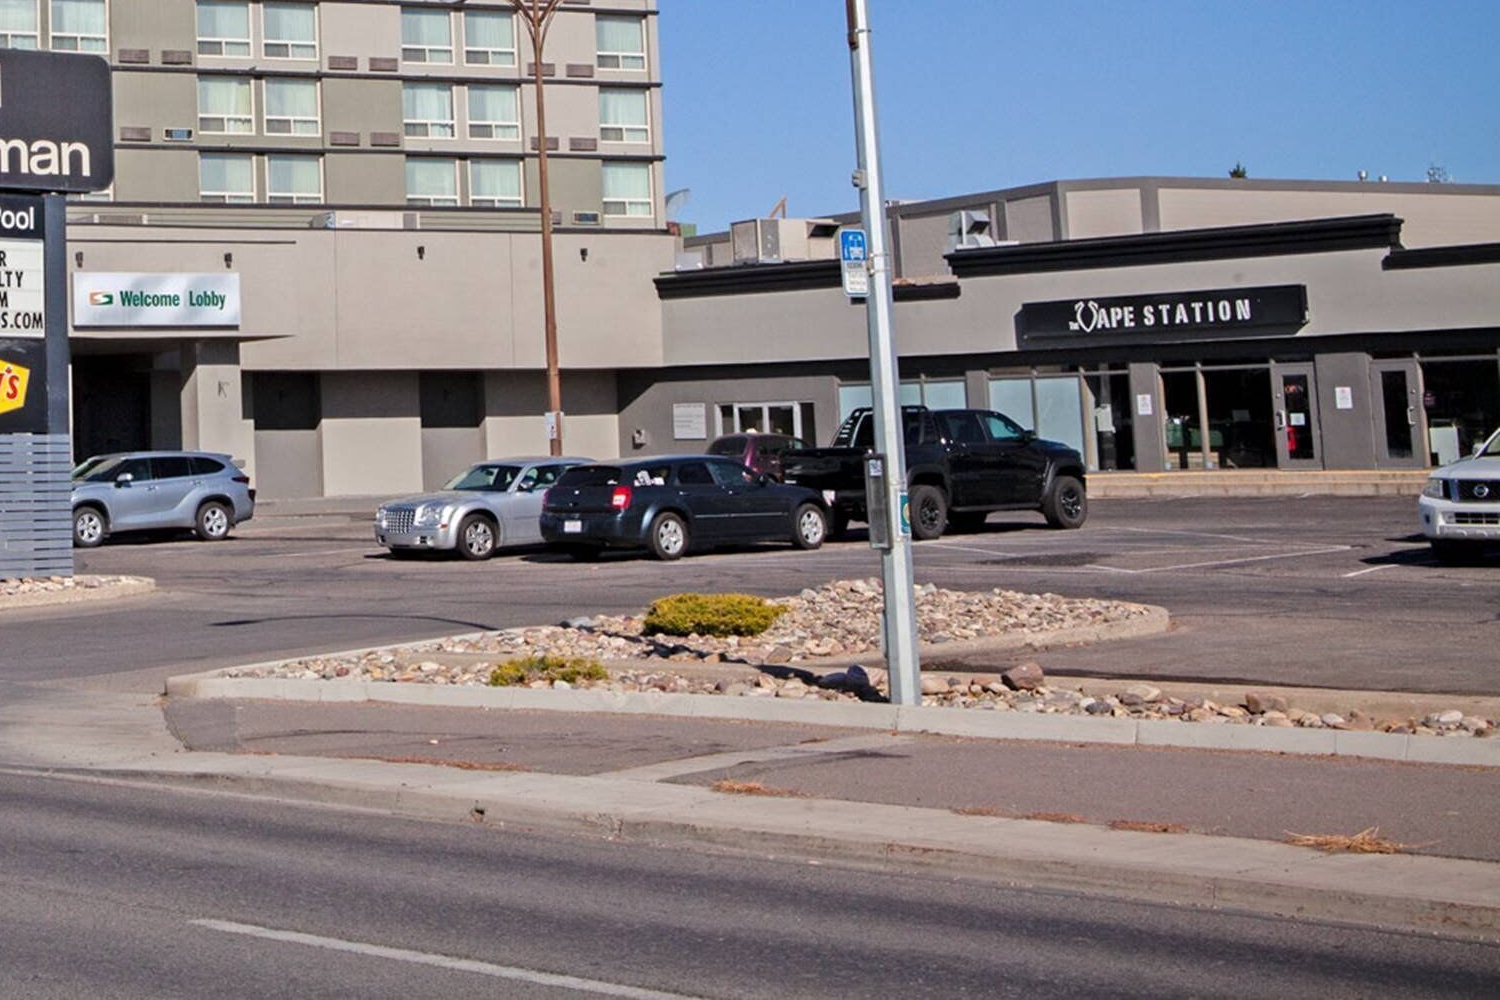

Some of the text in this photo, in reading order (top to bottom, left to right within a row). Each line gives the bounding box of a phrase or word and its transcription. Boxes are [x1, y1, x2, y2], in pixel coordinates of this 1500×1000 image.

[120, 290, 226, 310] Welcome Lobby
[1143, 299, 1252, 326] STATION
